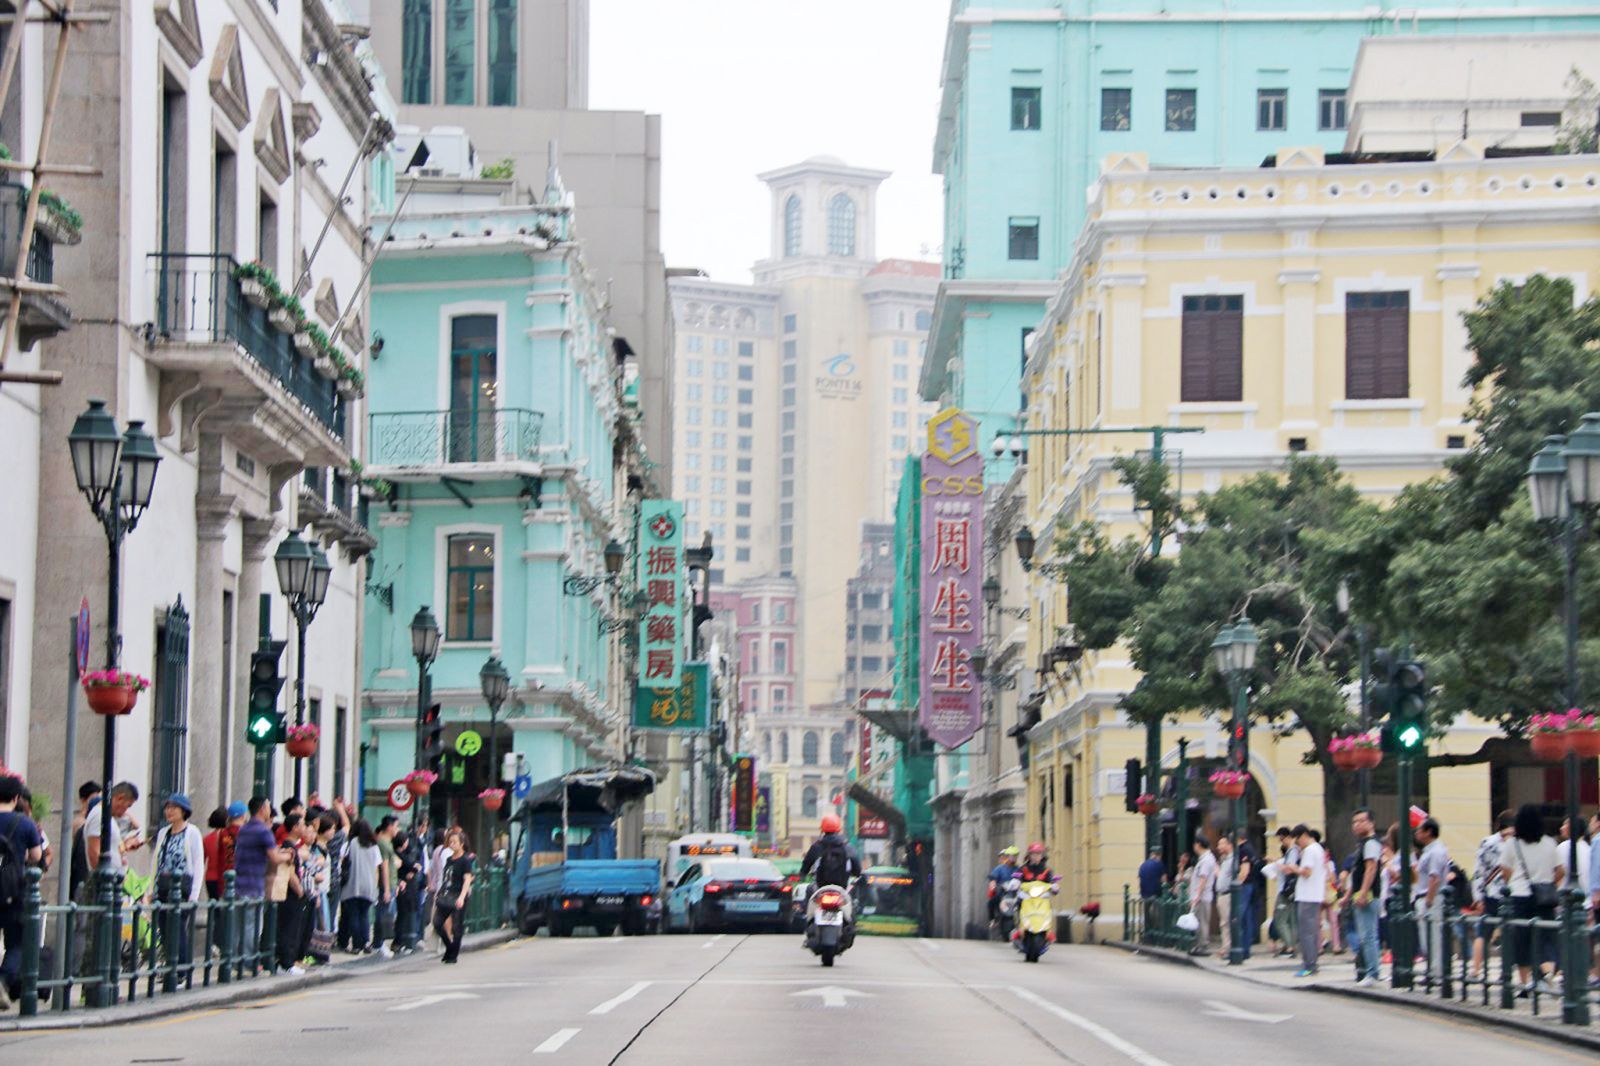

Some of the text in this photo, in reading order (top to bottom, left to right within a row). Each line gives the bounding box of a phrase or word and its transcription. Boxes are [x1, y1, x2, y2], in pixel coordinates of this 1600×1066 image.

[921, 475, 984, 497] CSS
[646, 545, 677, 680] 振興藥房
[930, 517, 974, 693] 周生生
